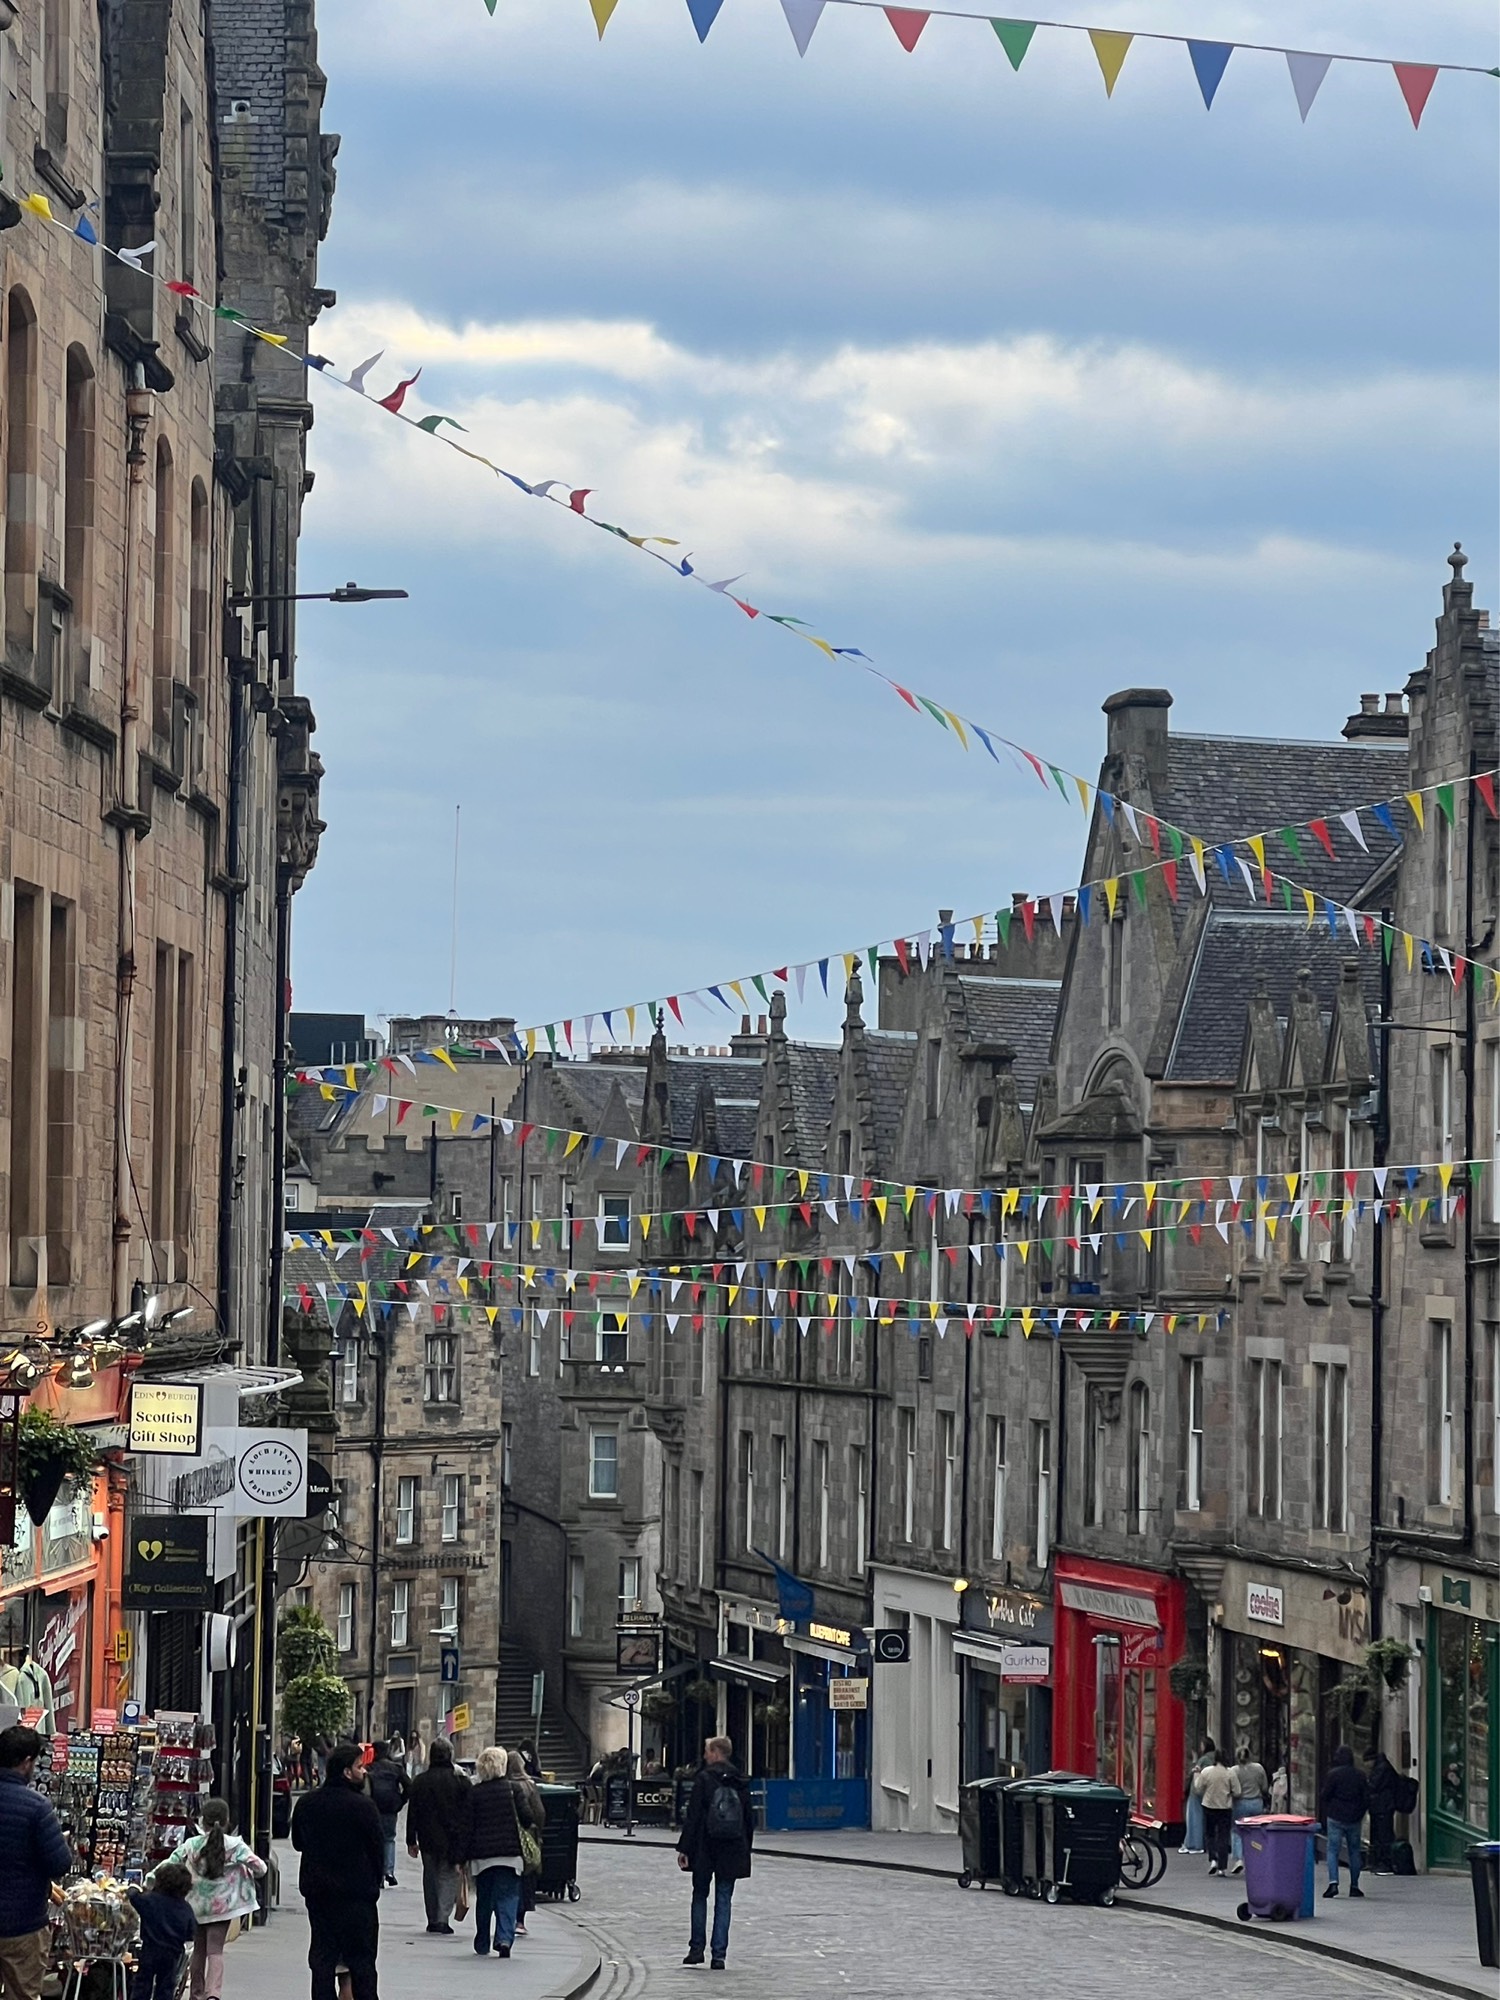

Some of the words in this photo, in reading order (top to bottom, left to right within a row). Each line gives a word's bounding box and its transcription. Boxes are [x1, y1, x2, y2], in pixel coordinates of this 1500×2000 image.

[136, 1411, 192, 1423] Scottish
[132, 1430, 155, 1442] Gift
[159, 1431, 195, 1446] Shop
[249, 1448, 270, 1465] LOCH
[272, 1448, 293, 1464] FYNE
[248, 1479, 293, 1497] EDINBURGH
[309, 1485, 330, 1493] More
[1004, 1654, 1047, 1667] Gurkha
[625, 1693, 637, 1701] 20
[637, 1793, 668, 1804] ECCO
